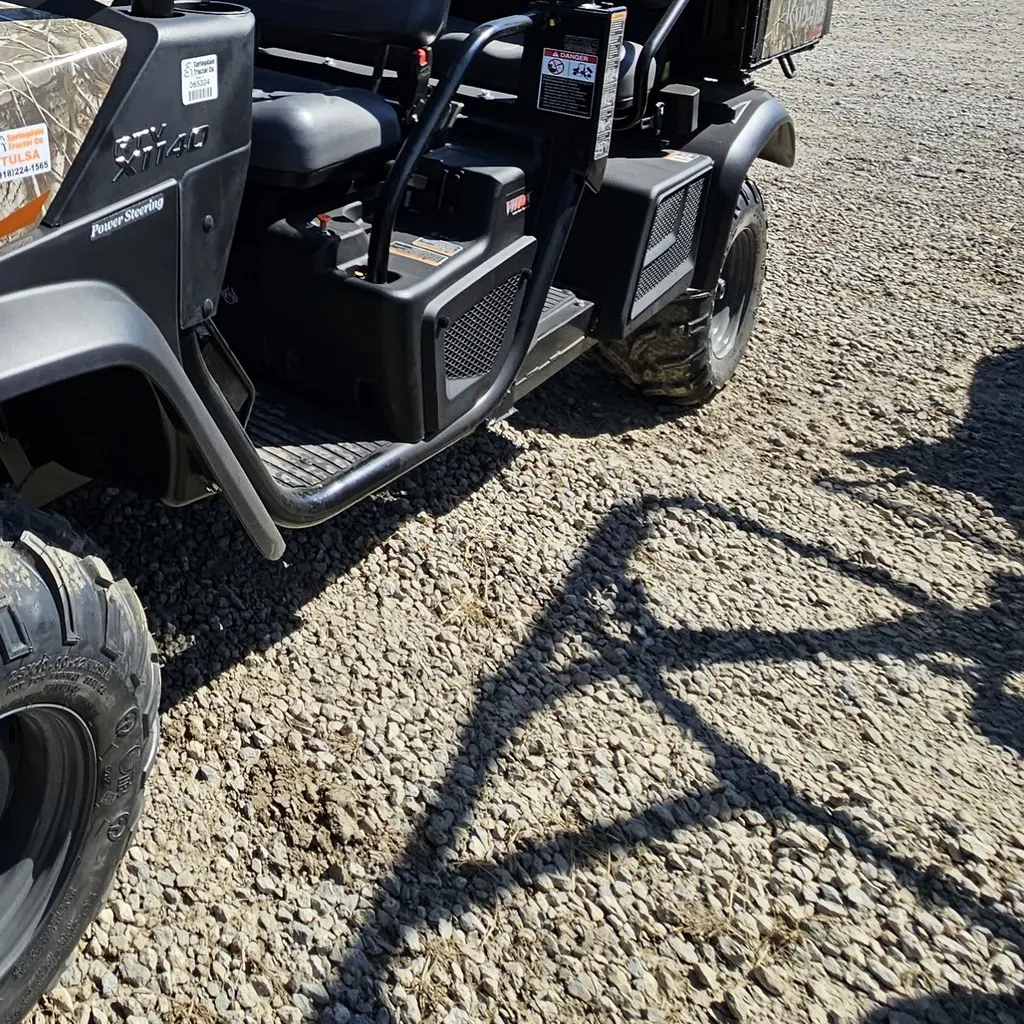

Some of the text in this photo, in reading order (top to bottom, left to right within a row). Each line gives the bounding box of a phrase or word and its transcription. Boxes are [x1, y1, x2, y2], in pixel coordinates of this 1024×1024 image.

[559, 52, 589, 62] DANGER
[7, 127, 45, 142] Springdale
[7, 140, 33, 151] Tractor
[0, 149, 41, 167] TULSA
[91, 197, 164, 238] Power Steering
